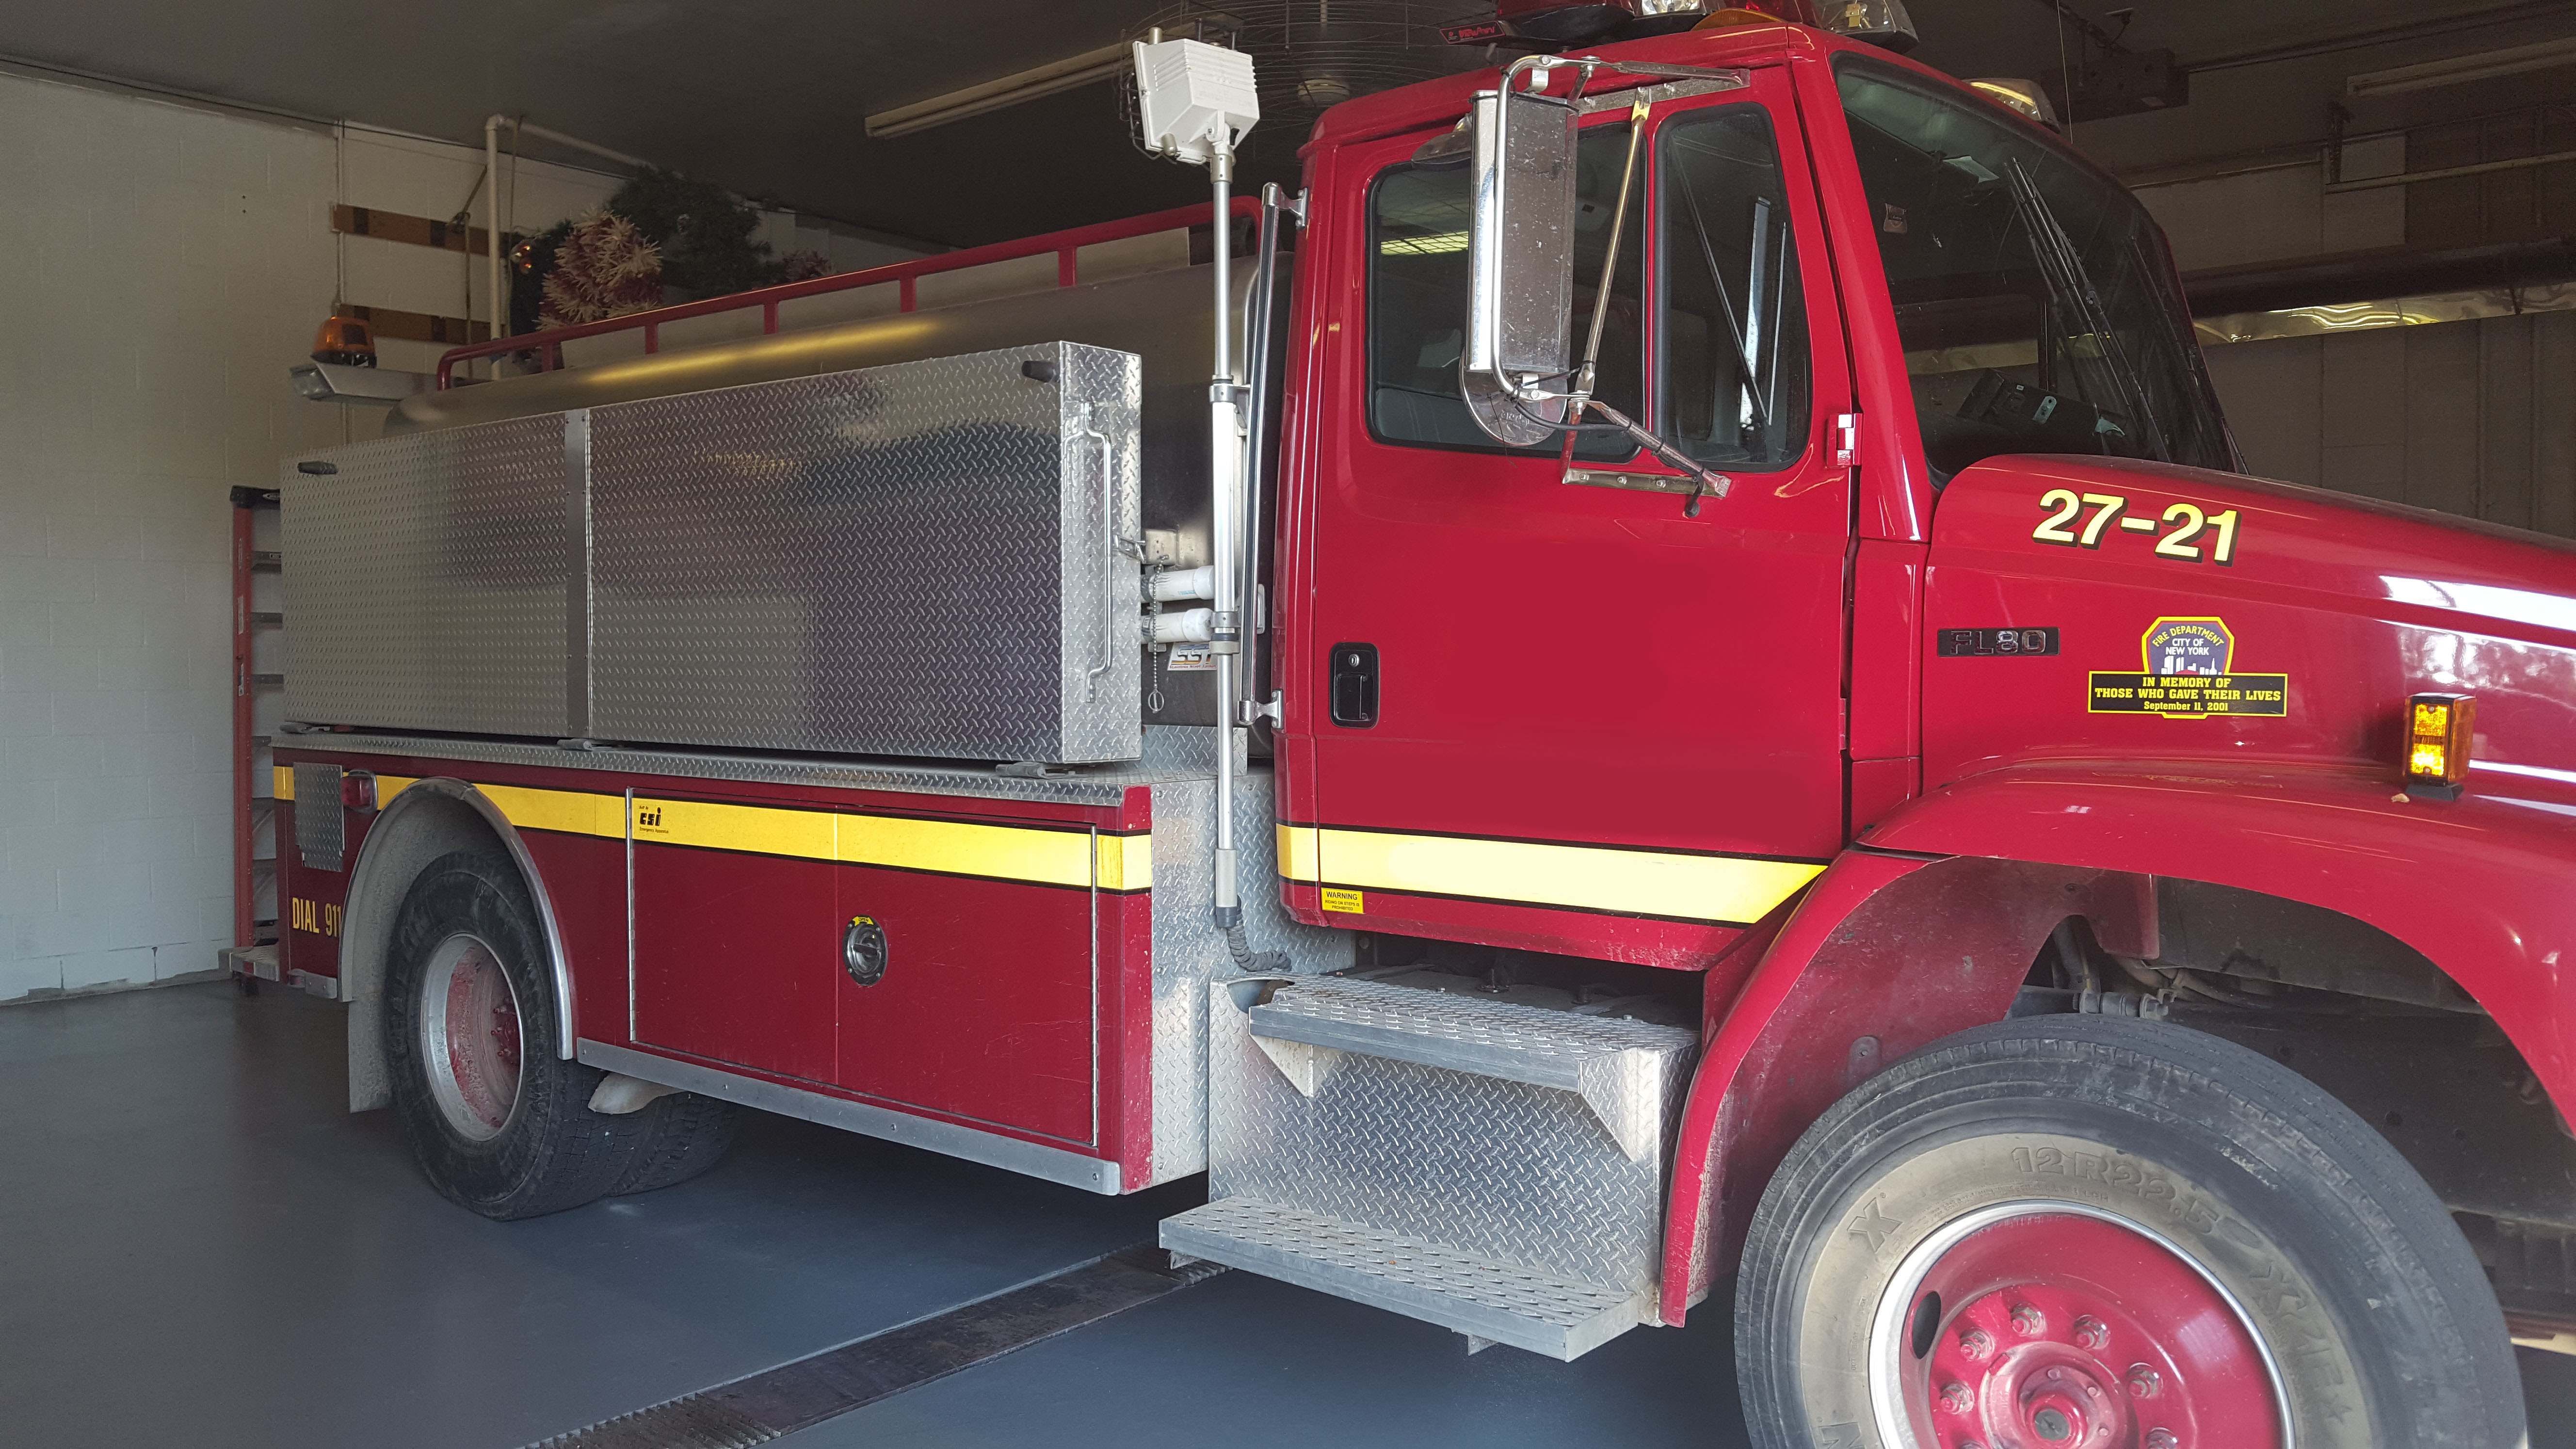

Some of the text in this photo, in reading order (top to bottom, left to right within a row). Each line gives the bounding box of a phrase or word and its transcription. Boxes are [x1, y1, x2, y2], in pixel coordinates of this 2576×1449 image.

[2031, 489, 2242, 567] 27-21
[1950, 630, 2046, 655] FL80
[2152, 626, 2224, 647] FIRE DEPARTMENT
[2172, 638, 2204, 646] CITY OF
[2166, 647, 2209, 655] NEW YORK
[2142, 677, 2231, 688] IN MEMORY OF
[2094, 688, 2281, 701] THOSE WHO GAVE THEIR LIVES
[2143, 701, 2228, 711] September 11, 2001
[1326, 891, 1357, 900] WARNING
[292, 897, 341, 937] DIAL 911
